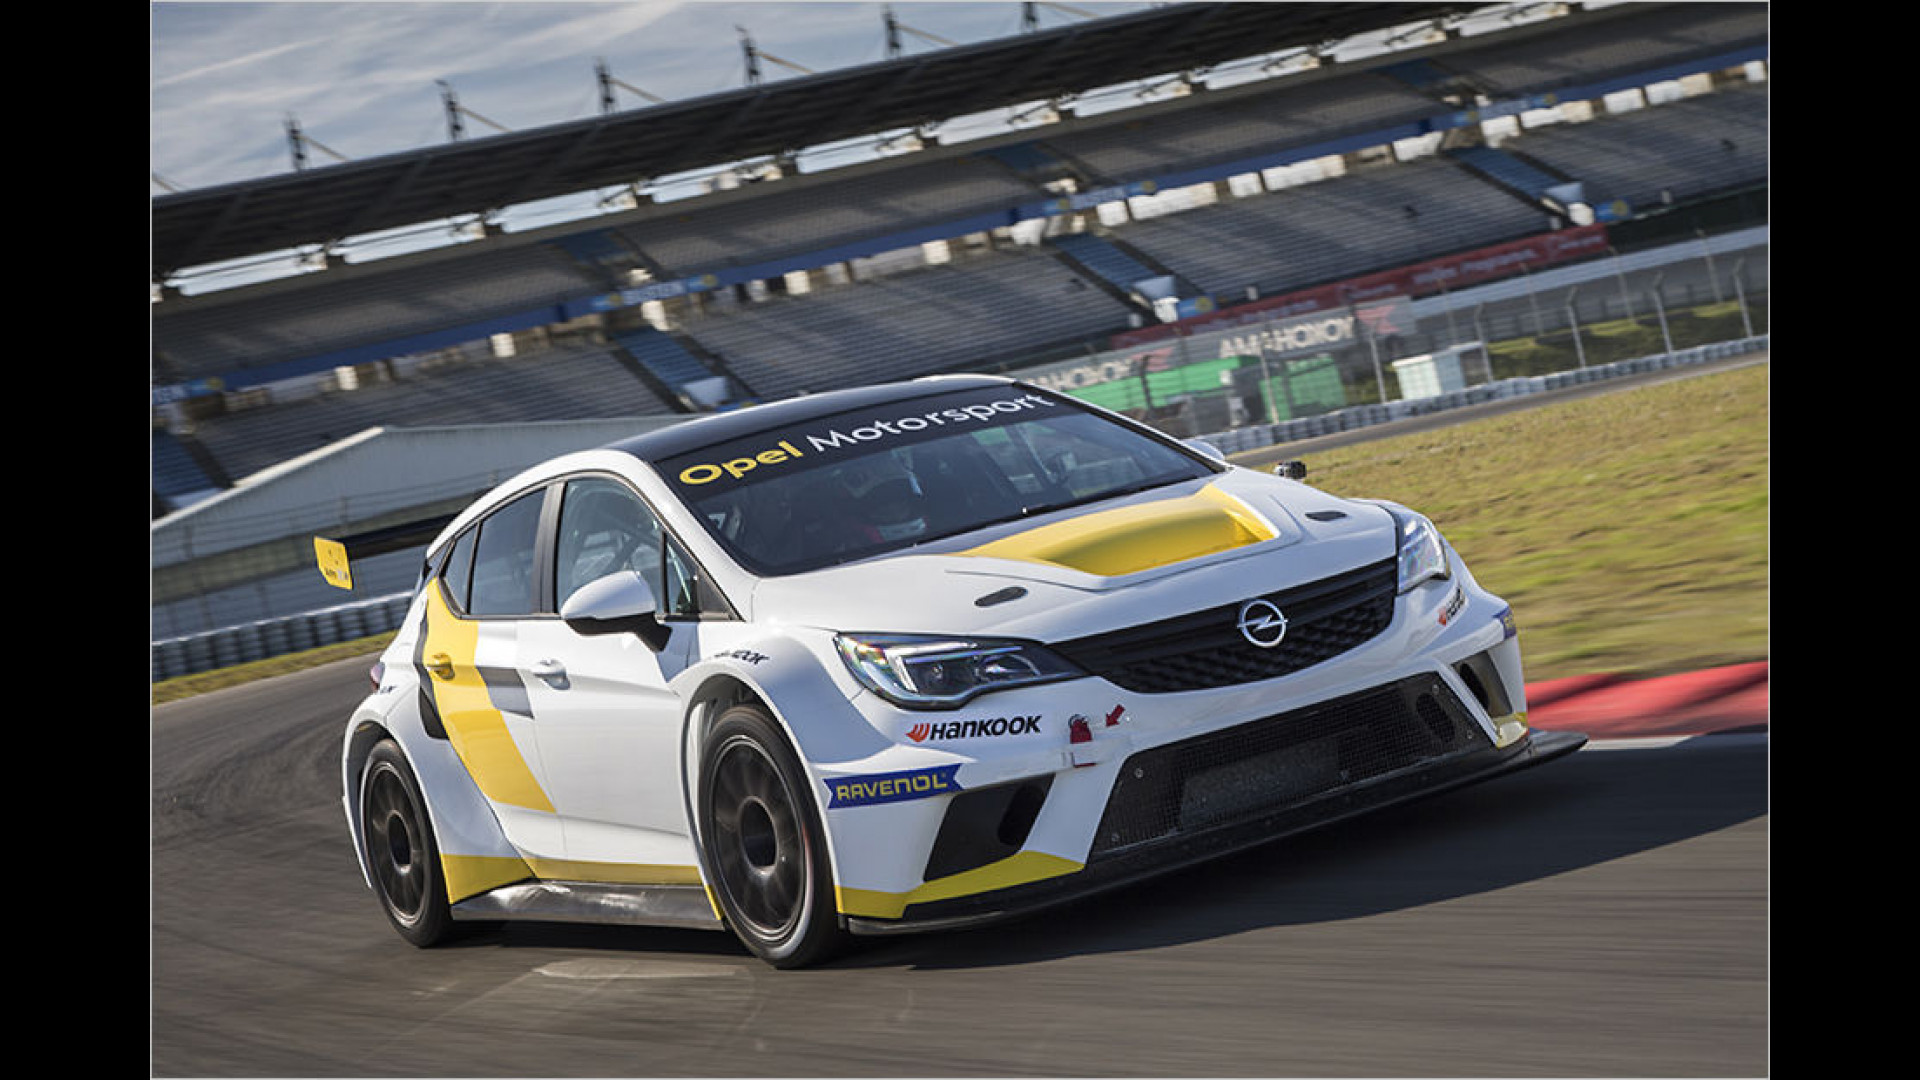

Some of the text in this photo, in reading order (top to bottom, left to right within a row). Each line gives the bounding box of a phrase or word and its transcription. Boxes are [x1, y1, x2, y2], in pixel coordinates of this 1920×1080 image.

[679, 394, 1056, 485] Opel Motorsport
[836, 773, 948, 802] RAVENOL
